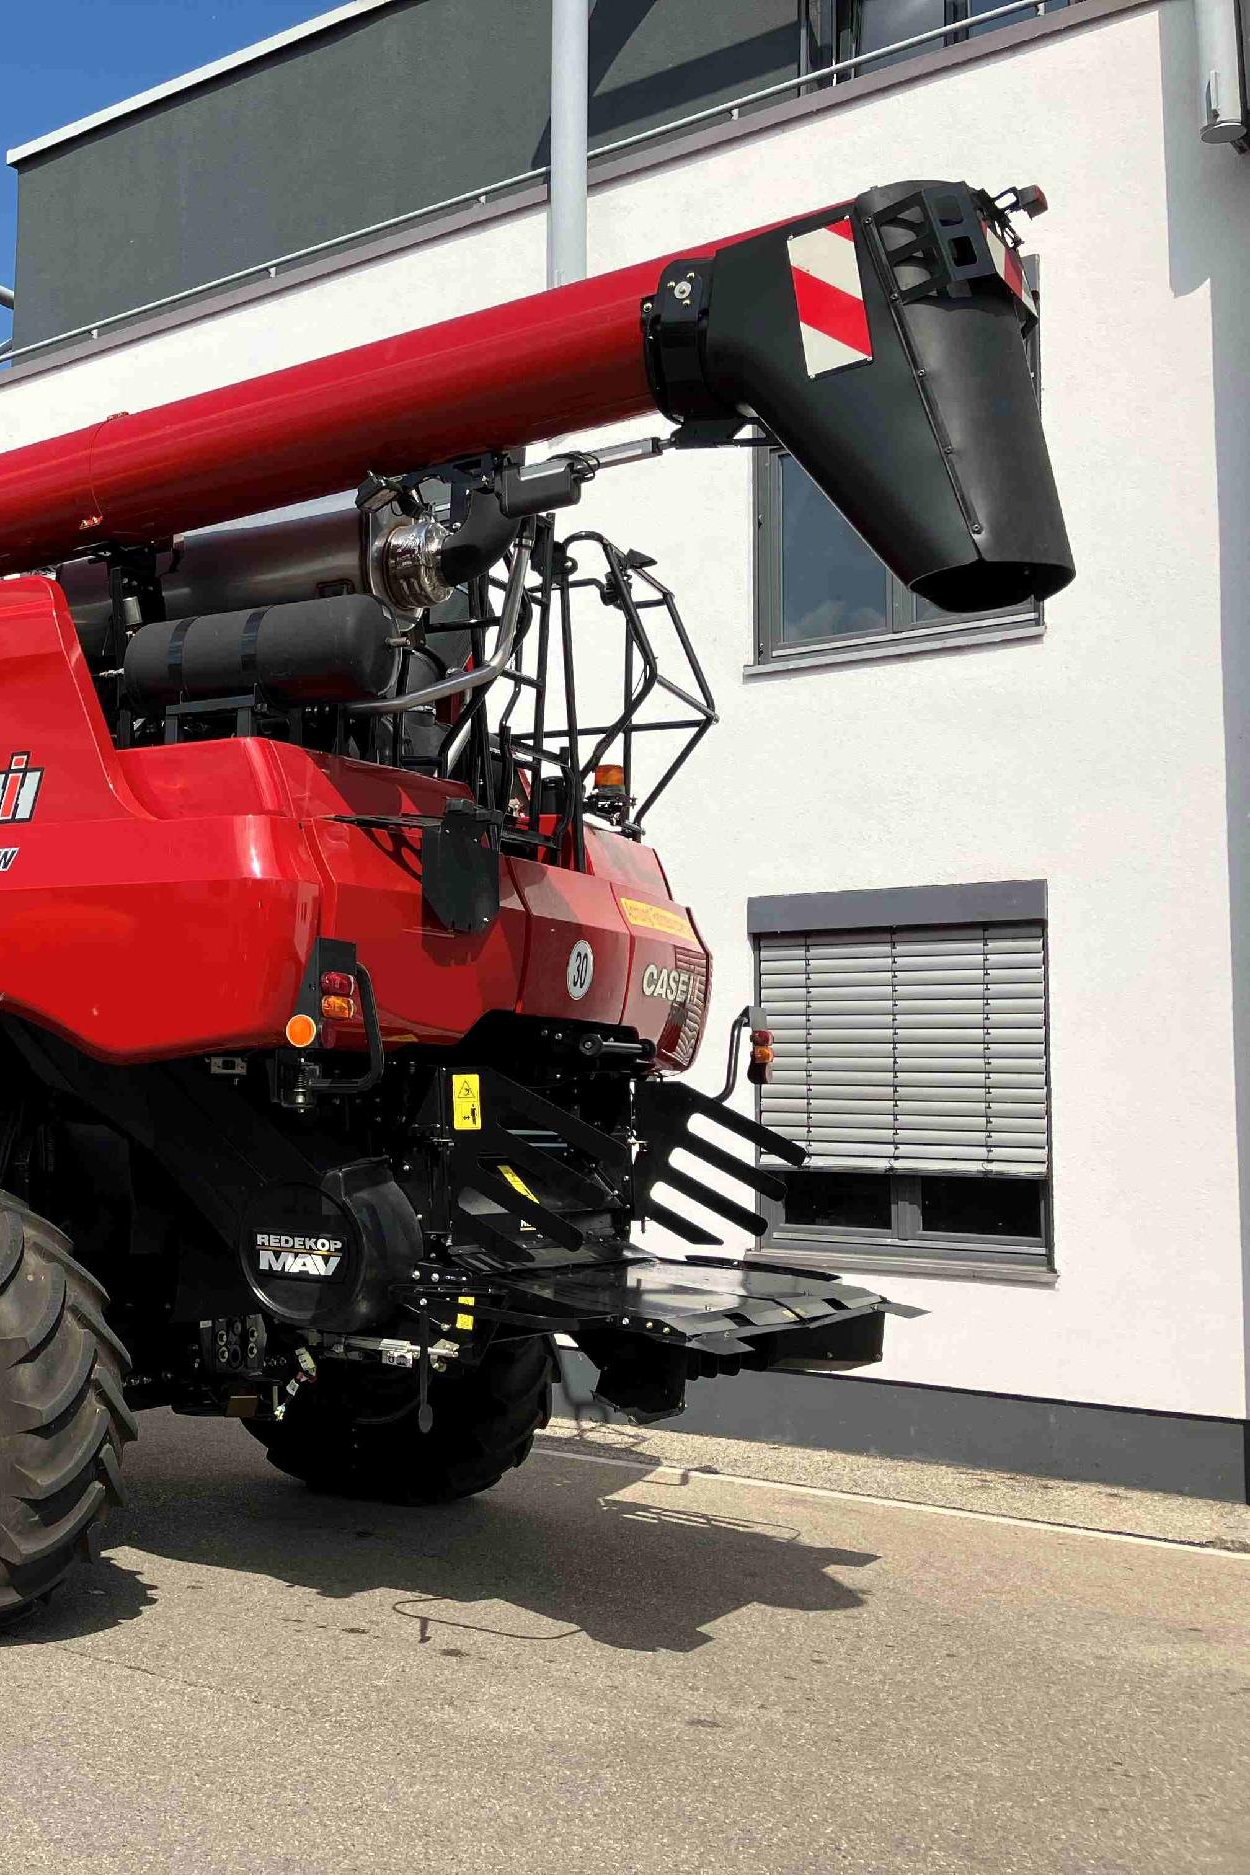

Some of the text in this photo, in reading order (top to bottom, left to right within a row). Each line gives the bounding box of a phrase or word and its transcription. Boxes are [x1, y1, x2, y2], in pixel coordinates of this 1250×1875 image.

[573, 951, 589, 988] 30
[643, 964, 689, 1002] CASE
[256, 1233, 343, 1252] REDEKOP
[259, 1250, 341, 1276] MAV
